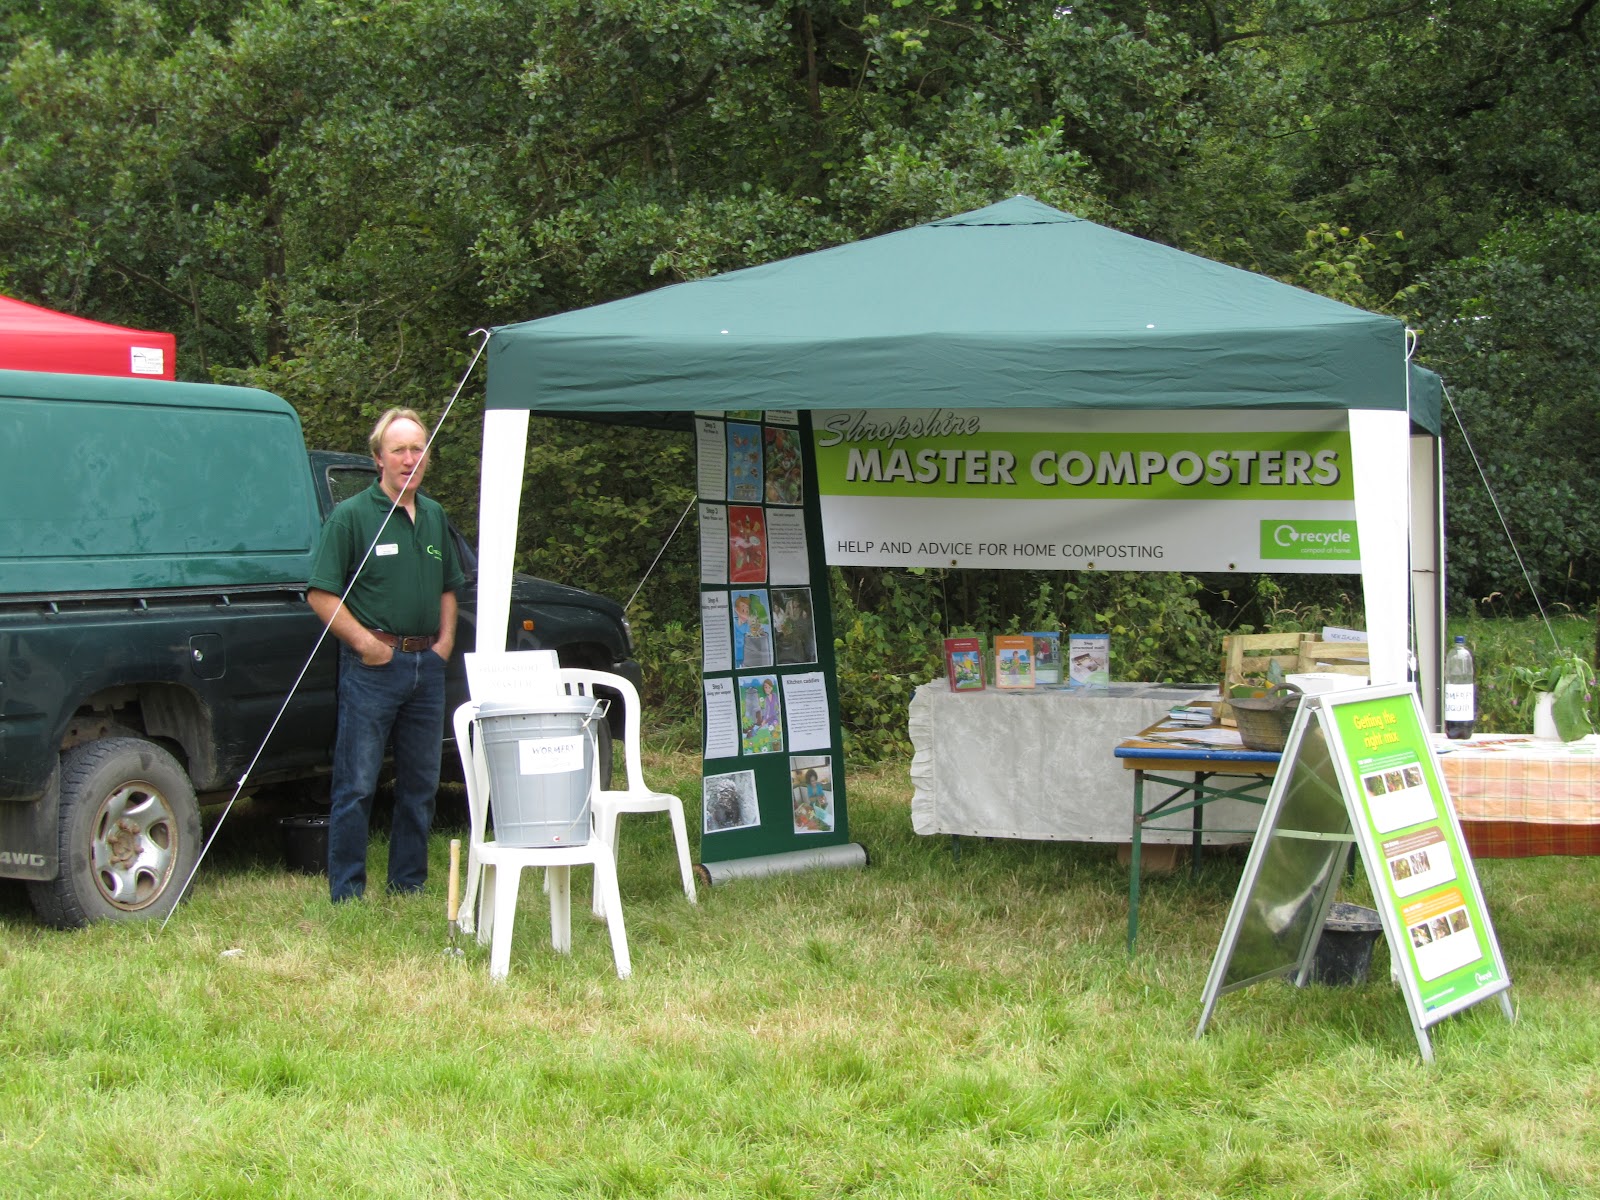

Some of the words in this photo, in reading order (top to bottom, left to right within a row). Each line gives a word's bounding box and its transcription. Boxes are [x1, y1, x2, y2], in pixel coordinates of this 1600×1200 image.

[818, 408, 981, 449] Shropshire
[845, 448, 1017, 485] MASTER
[1030, 449, 1341, 487] COMPOSTERS
[1300, 528, 1351, 545] recycle
[837, 541, 874, 553] HELP
[880, 541, 912, 554] AND
[917, 542, 972, 555] ADVICE
[979, 543, 1008, 556] FOR
[1013, 543, 1056, 557] HOME
[1062, 544, 1164, 559] COMPOSTING
[1353, 713, 1384, 730] Getting
[1382, 709, 1398, 725] the
[531, 743, 576, 755] WORMERY
[1364, 730, 1384, 751] right
[1383, 728, 1400, 744] mix
[0, 851, 46, 867] 4WD
